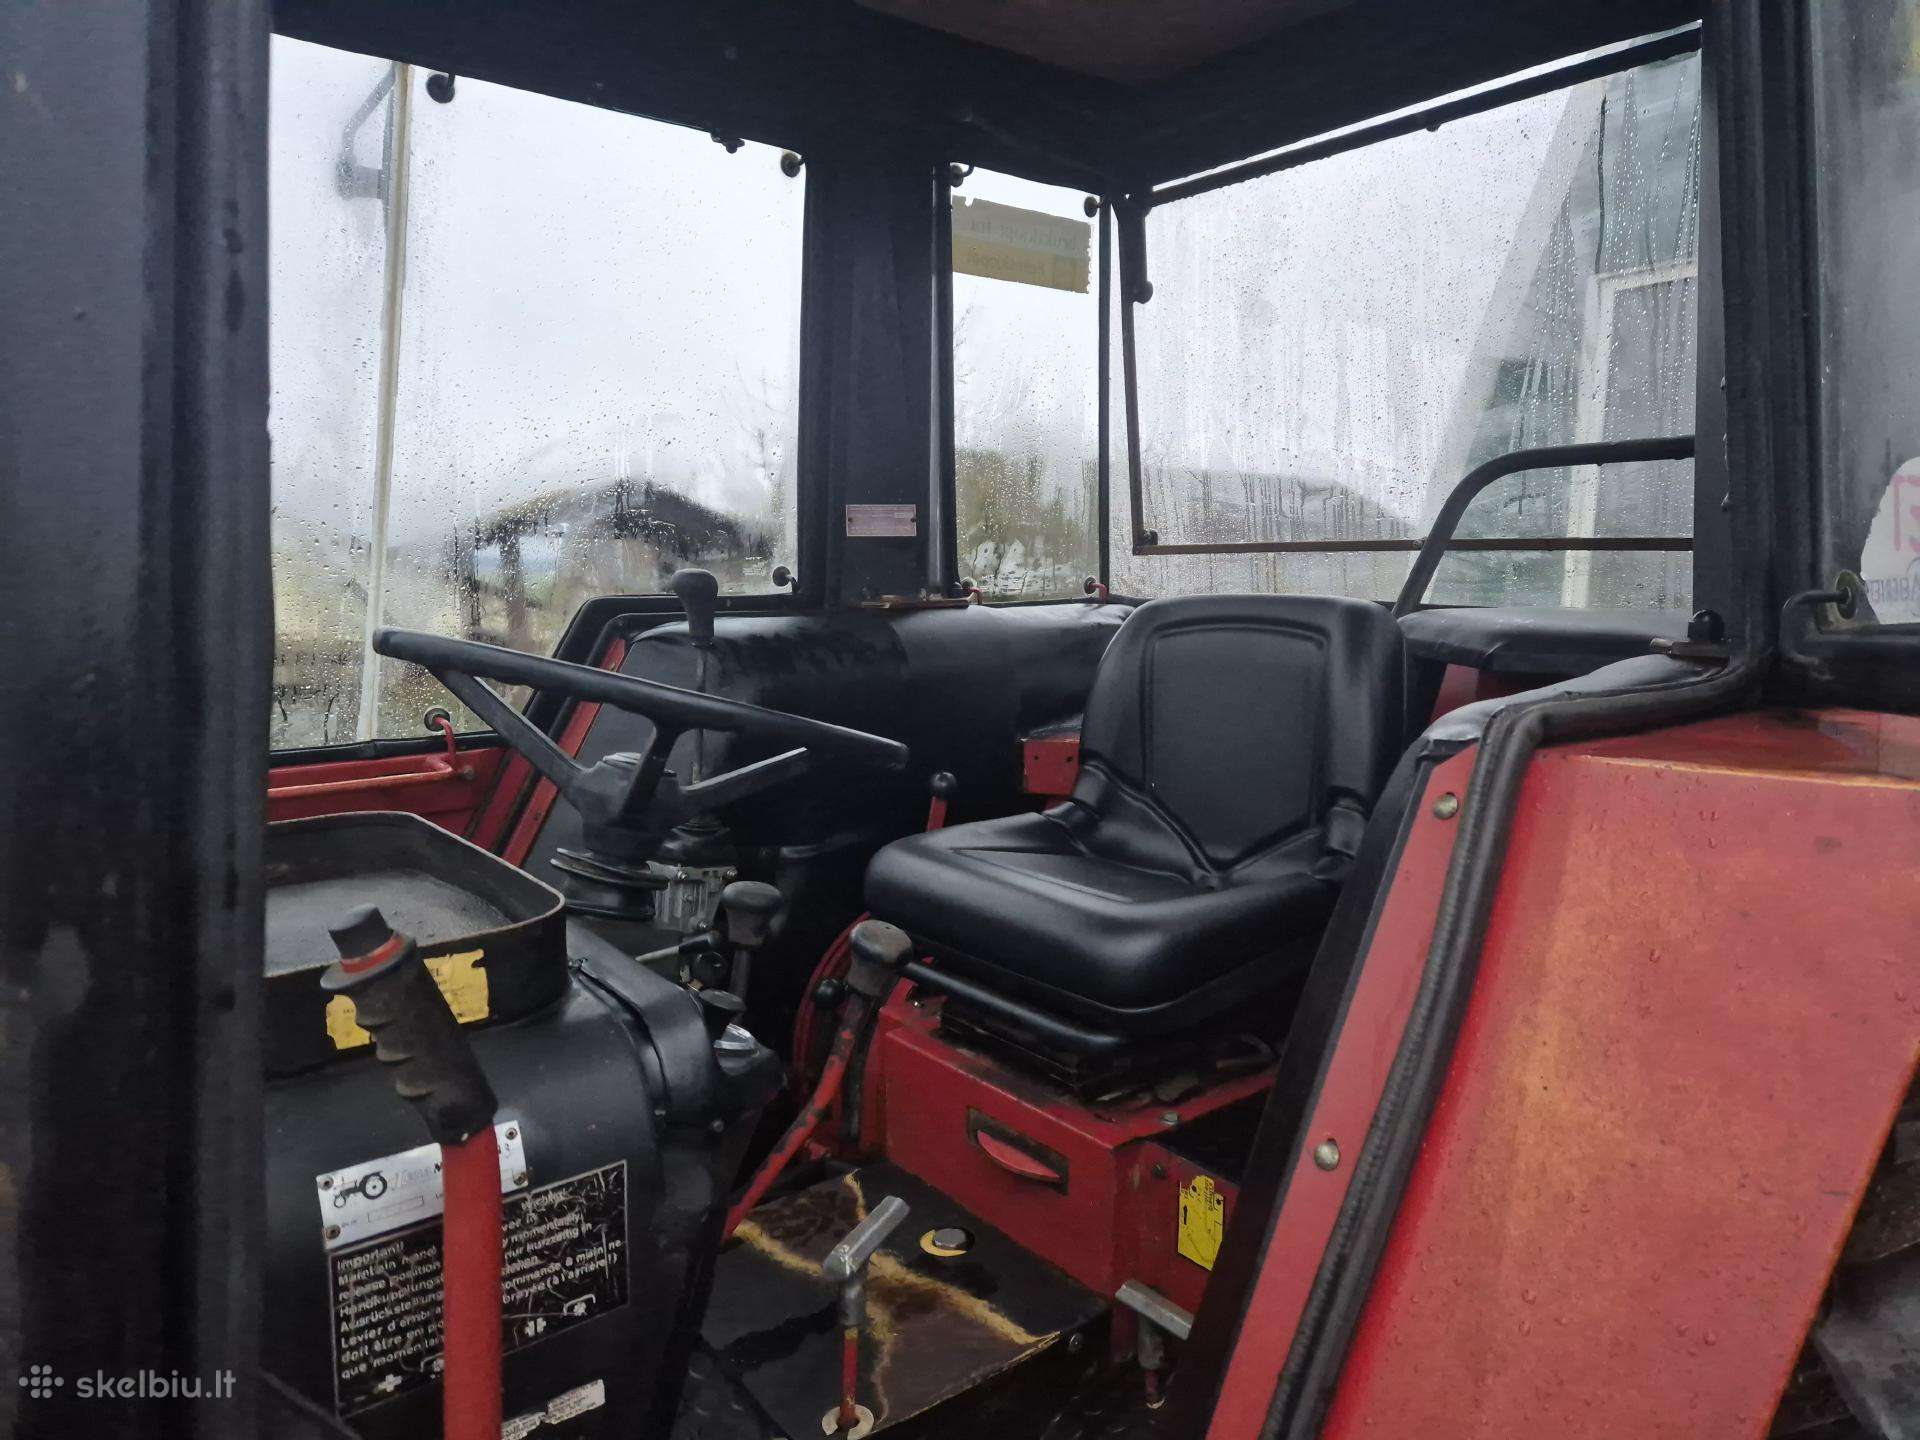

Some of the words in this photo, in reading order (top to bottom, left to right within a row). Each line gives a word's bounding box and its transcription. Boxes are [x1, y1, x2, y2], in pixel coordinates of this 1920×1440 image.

[502, 1218, 522, 1232] ver
[341, 1327, 383, 1349] Levier
[502, 1262, 561, 1289] ommande
[341, 1363, 367, 1380] que
